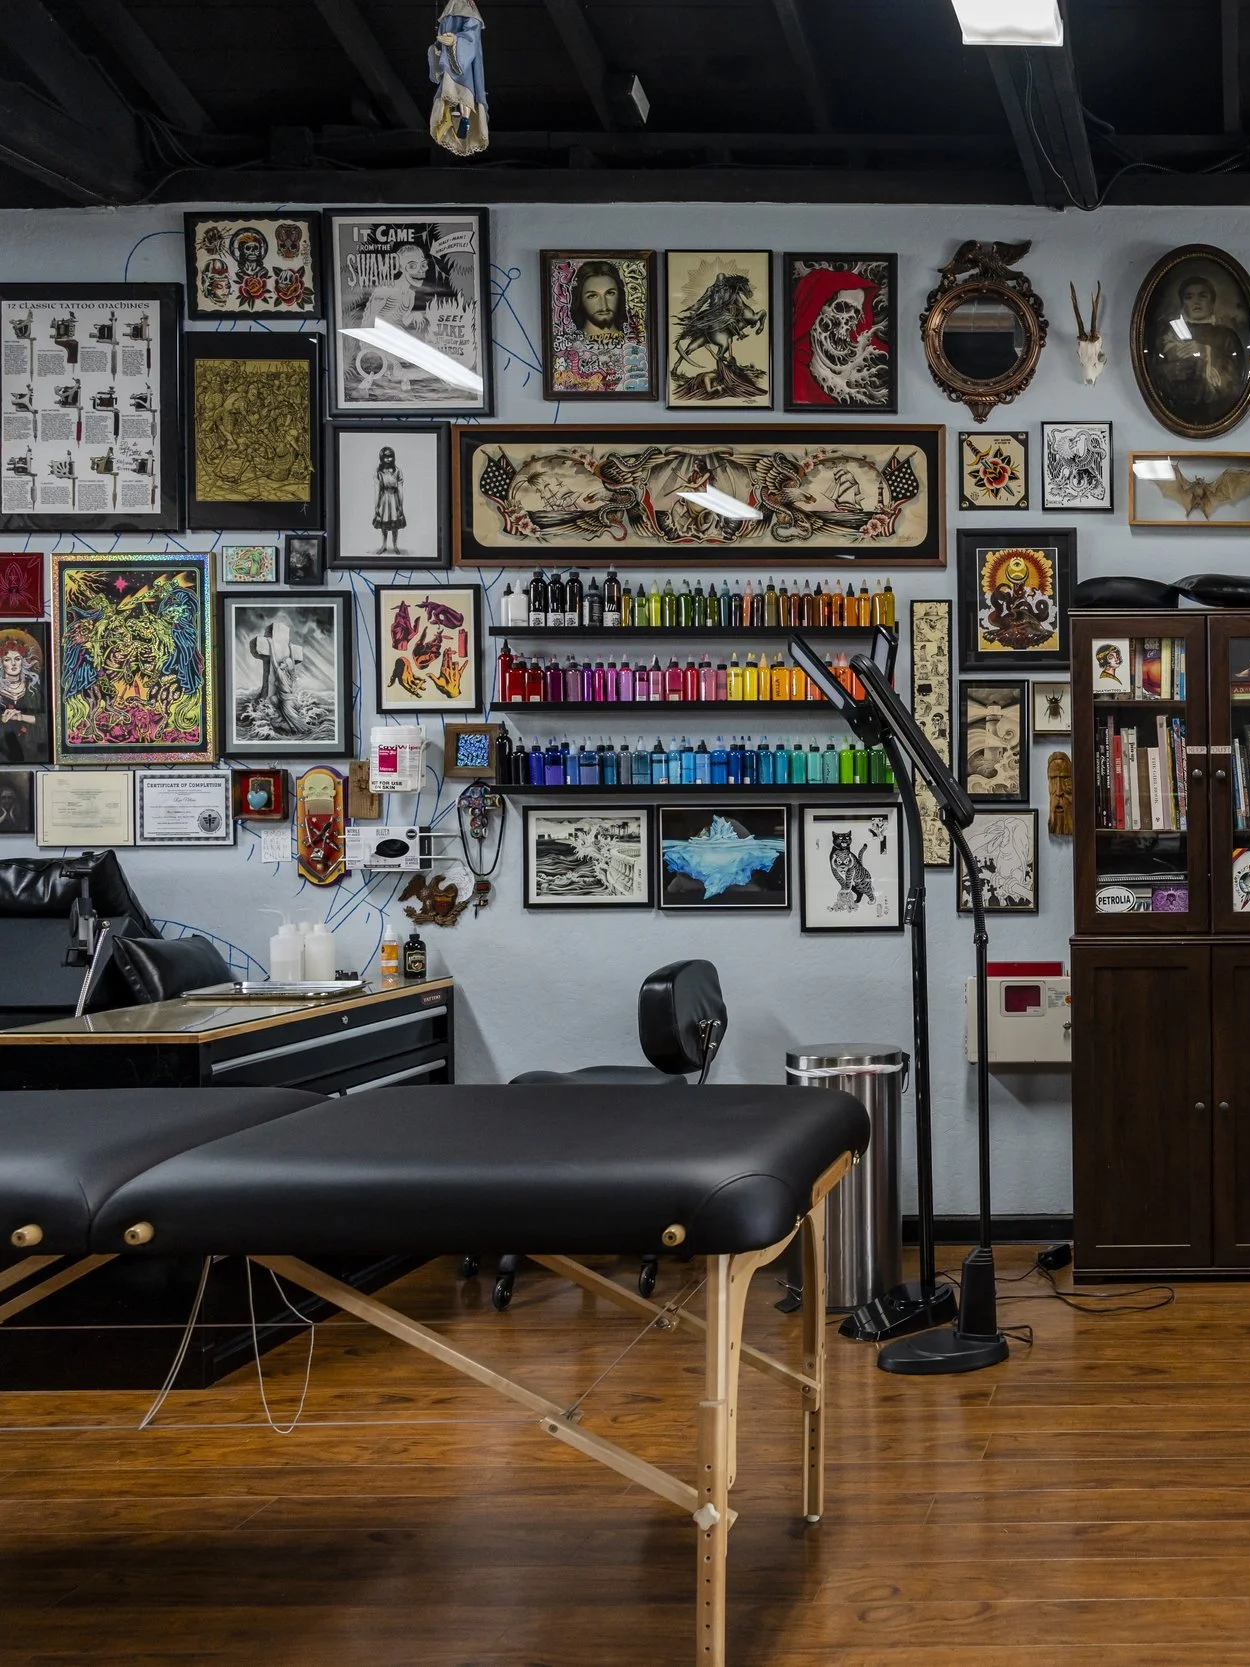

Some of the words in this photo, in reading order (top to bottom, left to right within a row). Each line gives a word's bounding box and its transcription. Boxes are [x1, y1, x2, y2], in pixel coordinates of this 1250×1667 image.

[352, 226, 371, 242] IT
[375, 225, 415, 242] CAME
[346, 253, 400, 287] SWAMP
[19, 302, 56, 310] CLASSIC
[59, 302, 96, 310] TATTOO
[437, 314, 464, 323] SEE!
[433, 323, 466, 339] JAKE
[1098, 895, 1131, 906] PETROLIA
